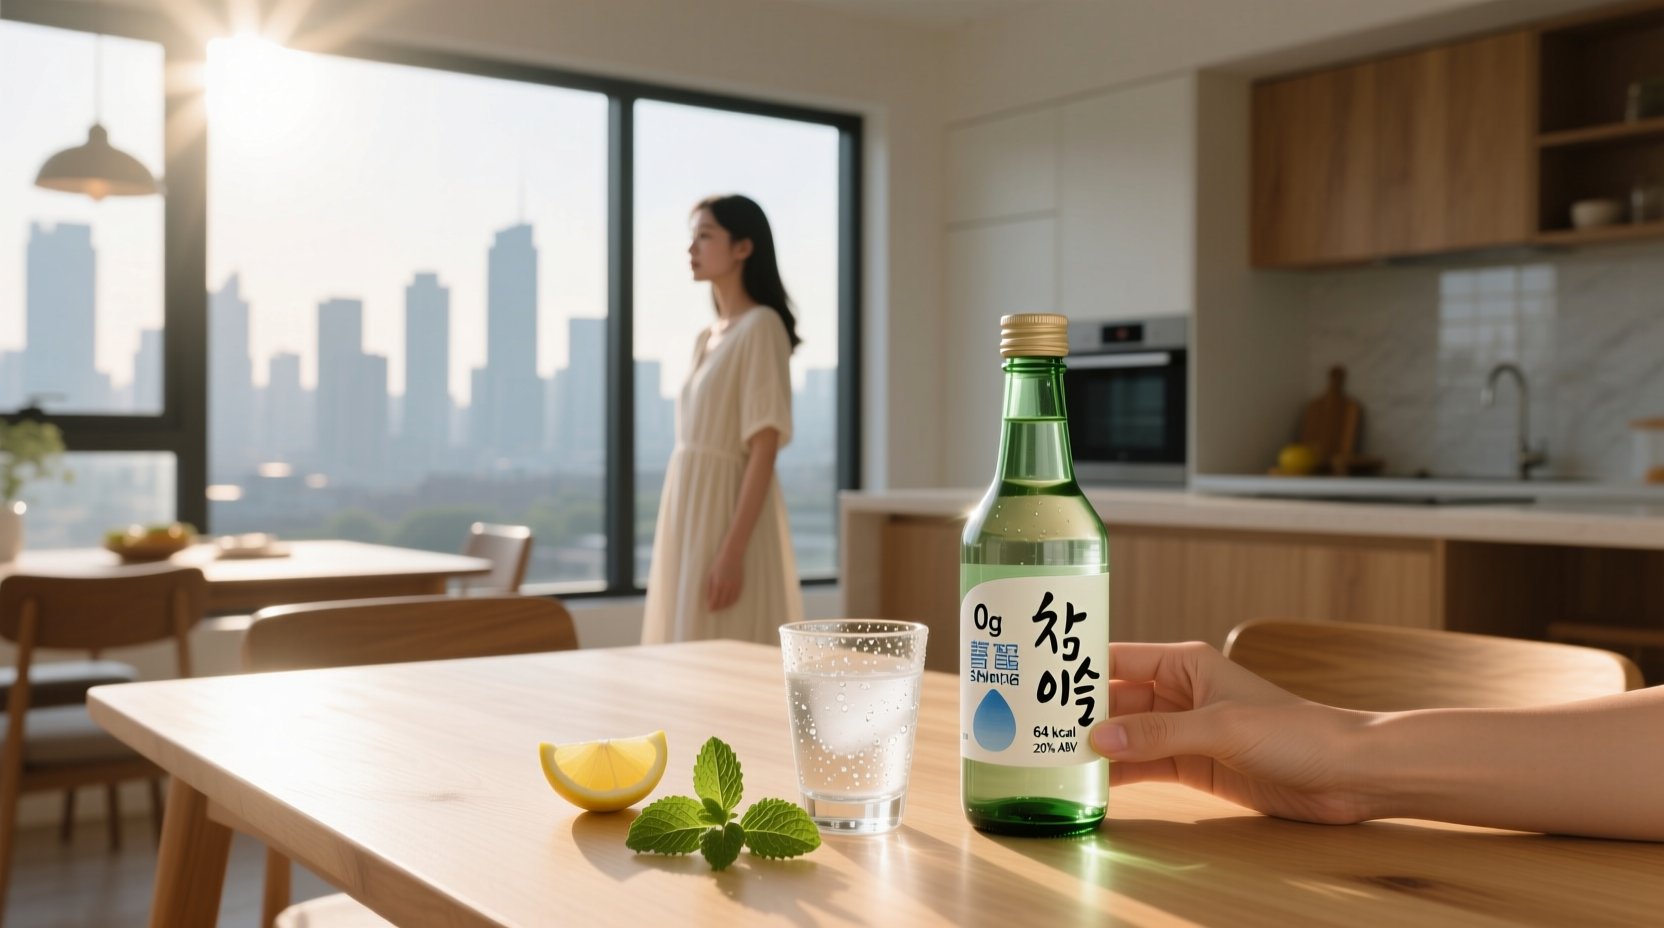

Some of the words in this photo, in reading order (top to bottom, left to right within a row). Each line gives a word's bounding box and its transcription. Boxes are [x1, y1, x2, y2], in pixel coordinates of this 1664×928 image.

[974, 603, 1002, 637] 0g
[1033, 726, 1049, 738] 64
[1052, 726, 1076, 738] kcal
[1033, 743, 1055, 754] 20%
[1057, 742, 1078, 753] ABV
